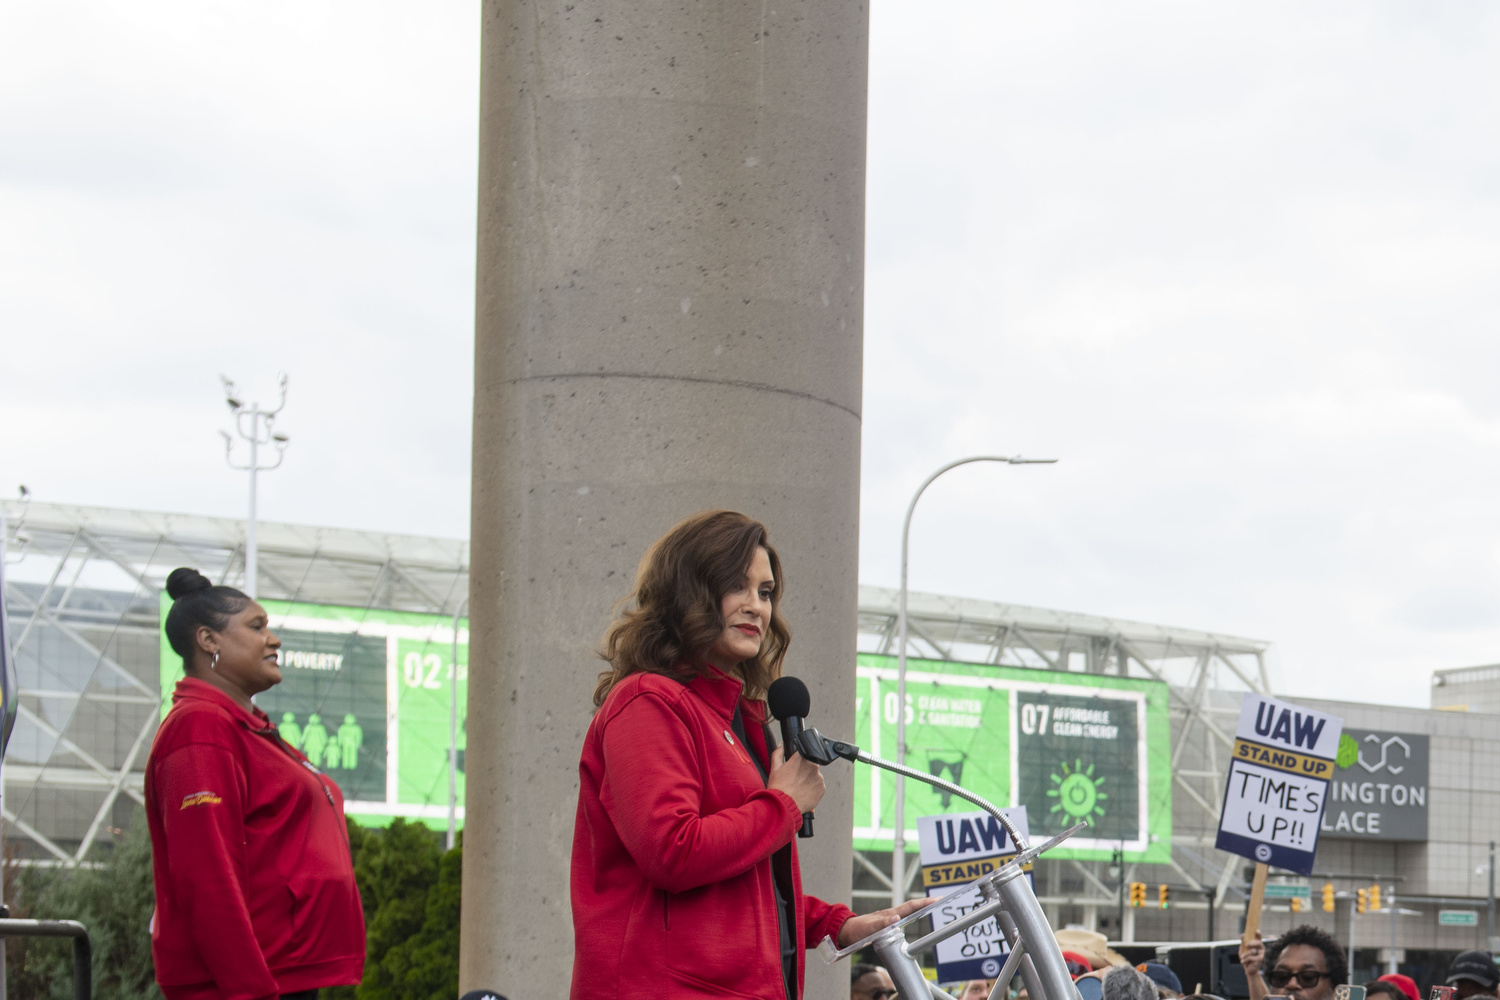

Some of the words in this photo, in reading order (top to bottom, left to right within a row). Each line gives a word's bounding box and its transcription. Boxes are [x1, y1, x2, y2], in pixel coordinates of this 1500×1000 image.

[285, 651, 344, 671] POVERTY
[404, 652, 442, 690] 02
[918, 696, 948, 711] CLEAN
[950, 698, 982, 713] WATER
[1053, 706, 1109, 725] AFFORDABLE
[1021, 703, 1050, 736] 07
[1053, 723, 1083, 737] CLEAN
[1083, 724, 1118, 740] ENERGY
[1255, 701, 1327, 750] UAW
[1239, 744, 1297, 768] STAND
[1302, 760, 1327, 774] UP
[1236, 770, 1320, 813] TIME'S
[1332, 780, 1425, 806] INGTON
[935, 813, 1009, 855] UAW
[1321, 811, 1381, 834] LACE
[930, 862, 994, 883] STAND
[961, 939, 1007, 958] OUT
